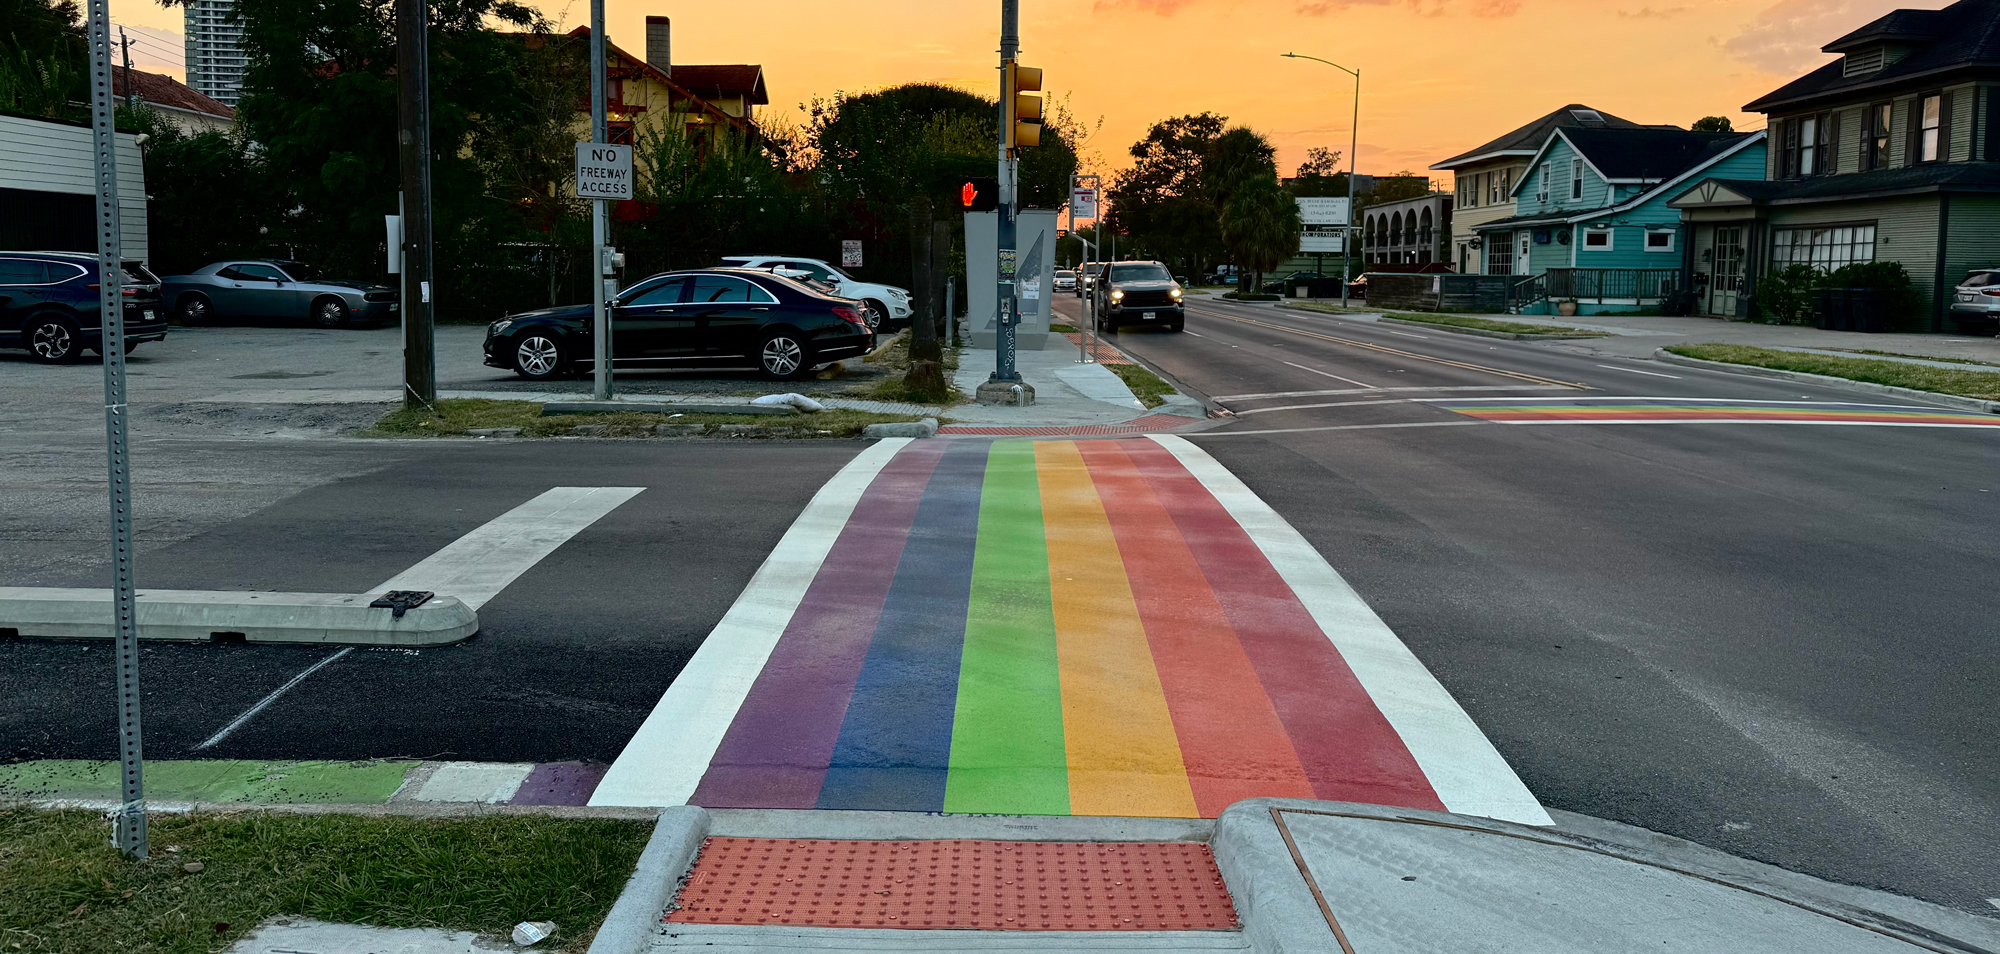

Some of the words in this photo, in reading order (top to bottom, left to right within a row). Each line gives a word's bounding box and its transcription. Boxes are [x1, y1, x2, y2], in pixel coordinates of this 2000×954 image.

[592, 149, 616, 162] NO
[581, 166, 627, 179] FREEWAY
[581, 181, 627, 194] ACCESS
